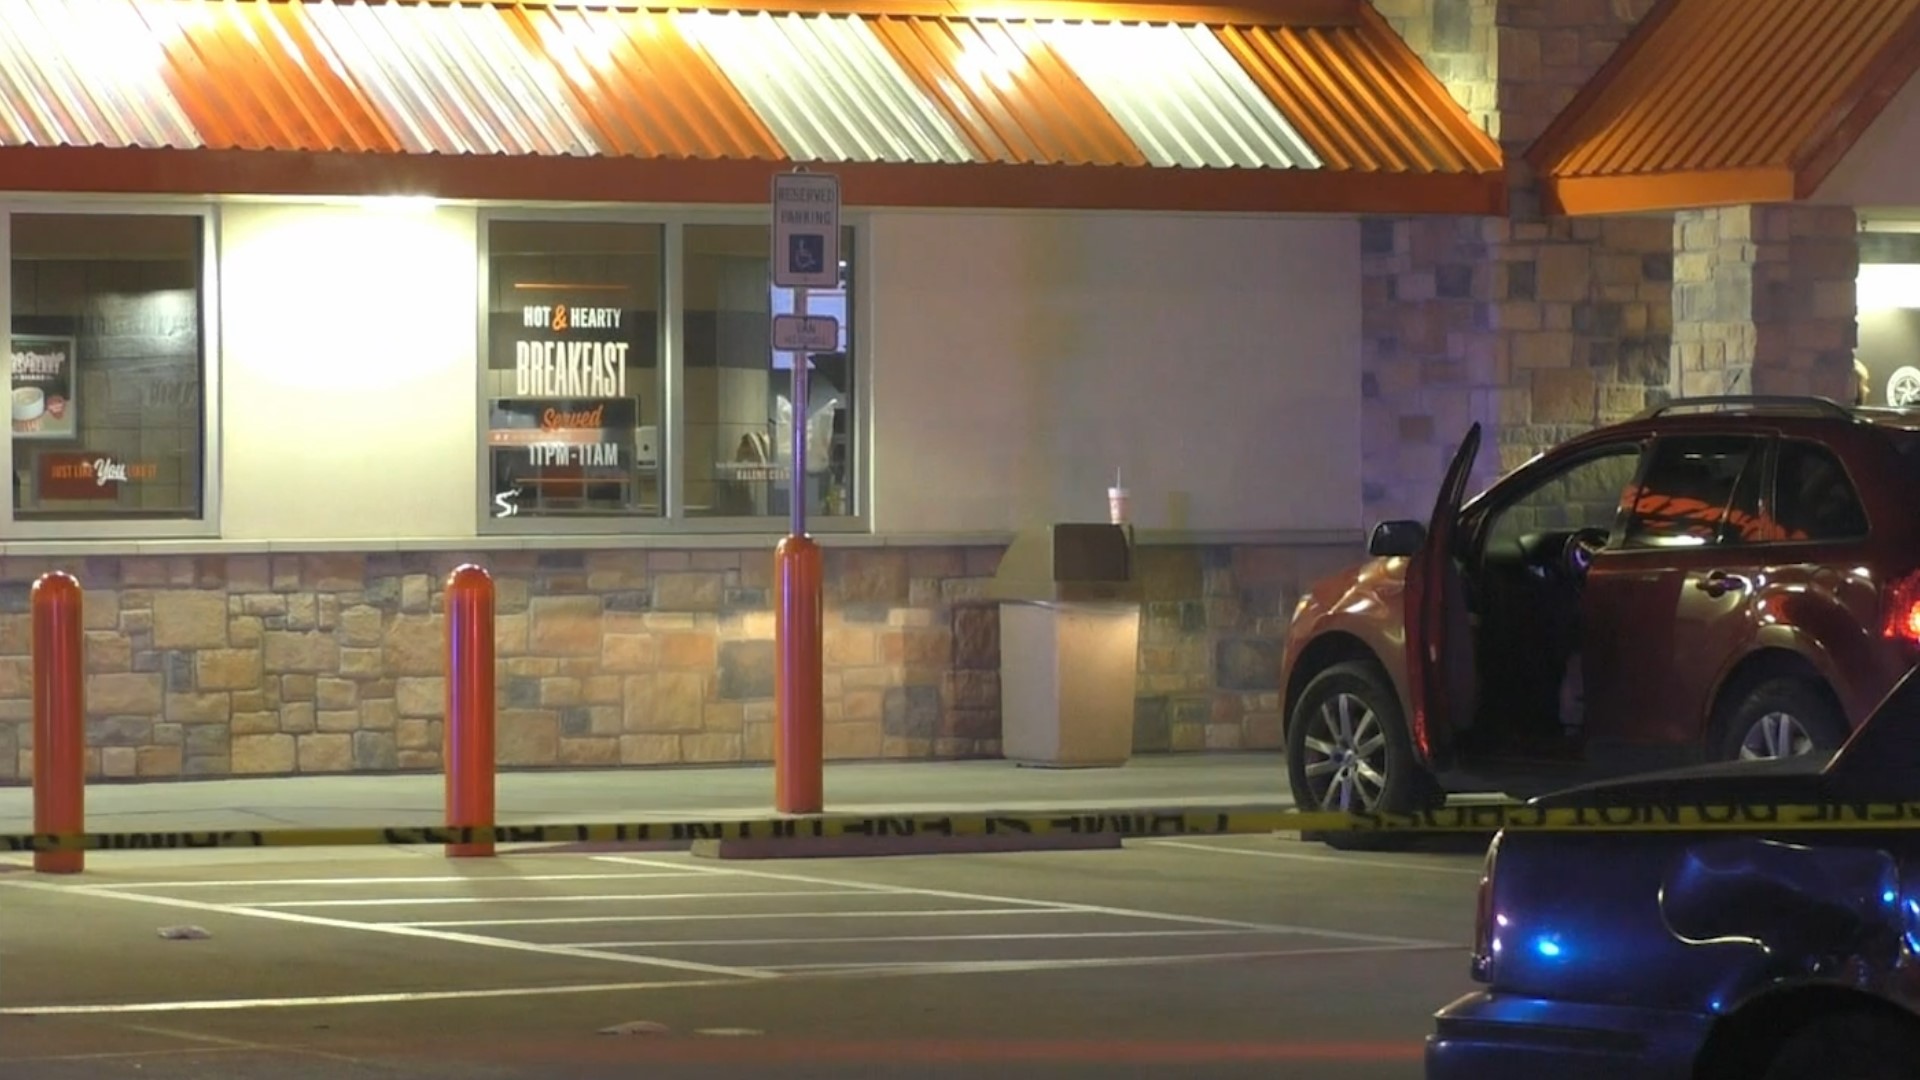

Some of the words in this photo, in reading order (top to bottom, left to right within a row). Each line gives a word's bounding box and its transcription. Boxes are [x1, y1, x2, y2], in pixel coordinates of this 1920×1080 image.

[781, 210, 832, 224] PARKING
[523, 305, 551, 328] HOT
[552, 304, 568, 331] &
[570, 307, 622, 328] HEARTY
[516, 340, 629, 398] BREAKFAST
[541, 404, 604, 432] Served
[93, 457, 128, 487] You
